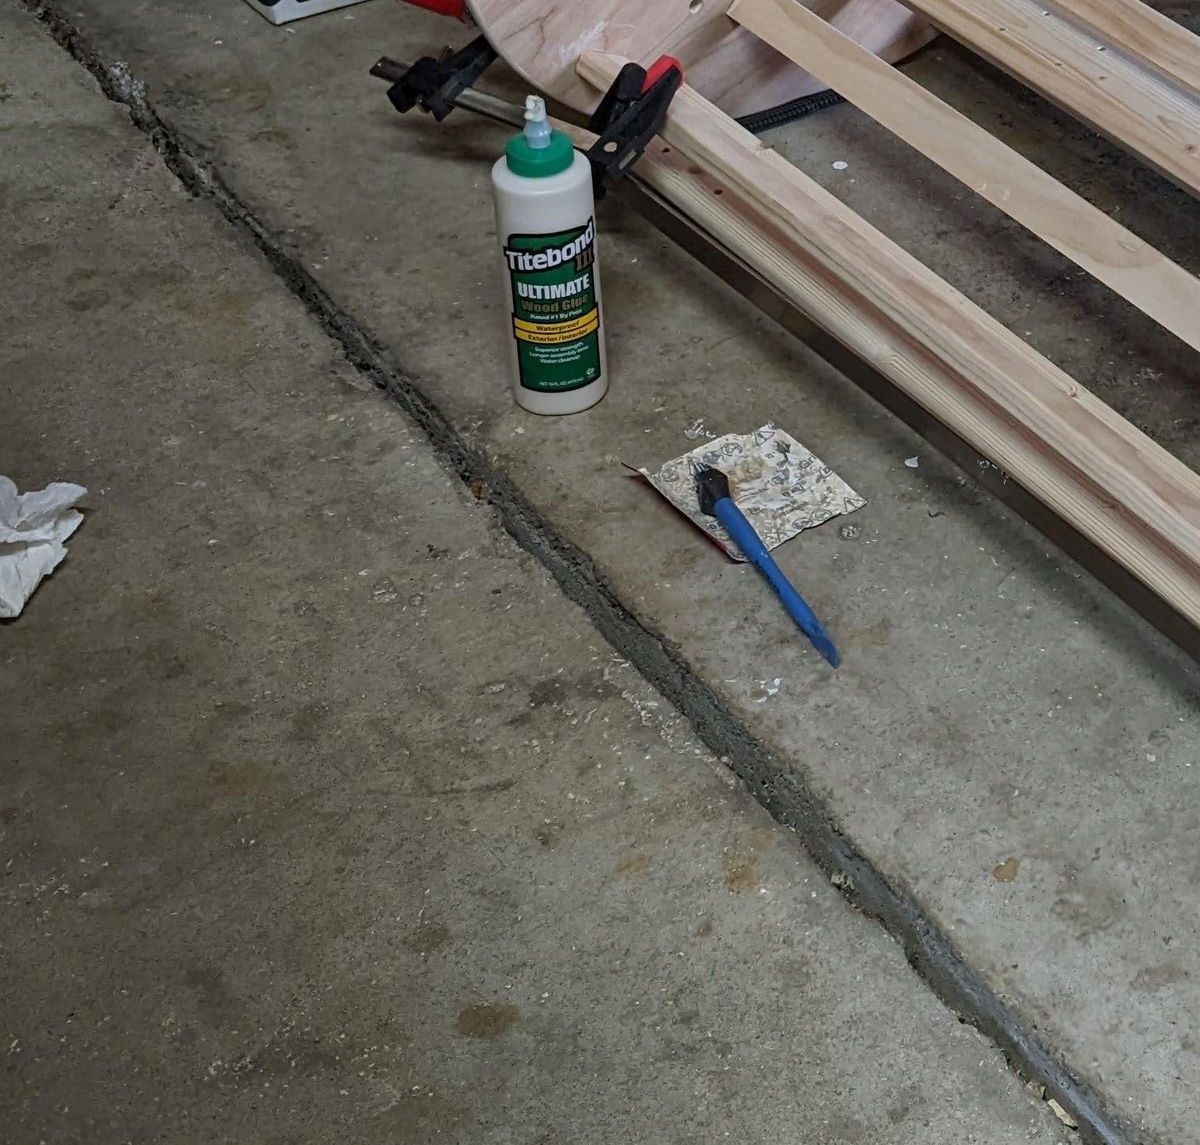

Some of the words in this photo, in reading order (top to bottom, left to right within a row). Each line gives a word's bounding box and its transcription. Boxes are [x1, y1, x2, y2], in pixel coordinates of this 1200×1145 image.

[506, 221, 593, 271] Titebond
[517, 274, 590, 300] ULTIMATE
[521, 300, 559, 313] Wood
[561, 296, 589, 311] Glue
[535, 320, 579, 332] Waterproof
